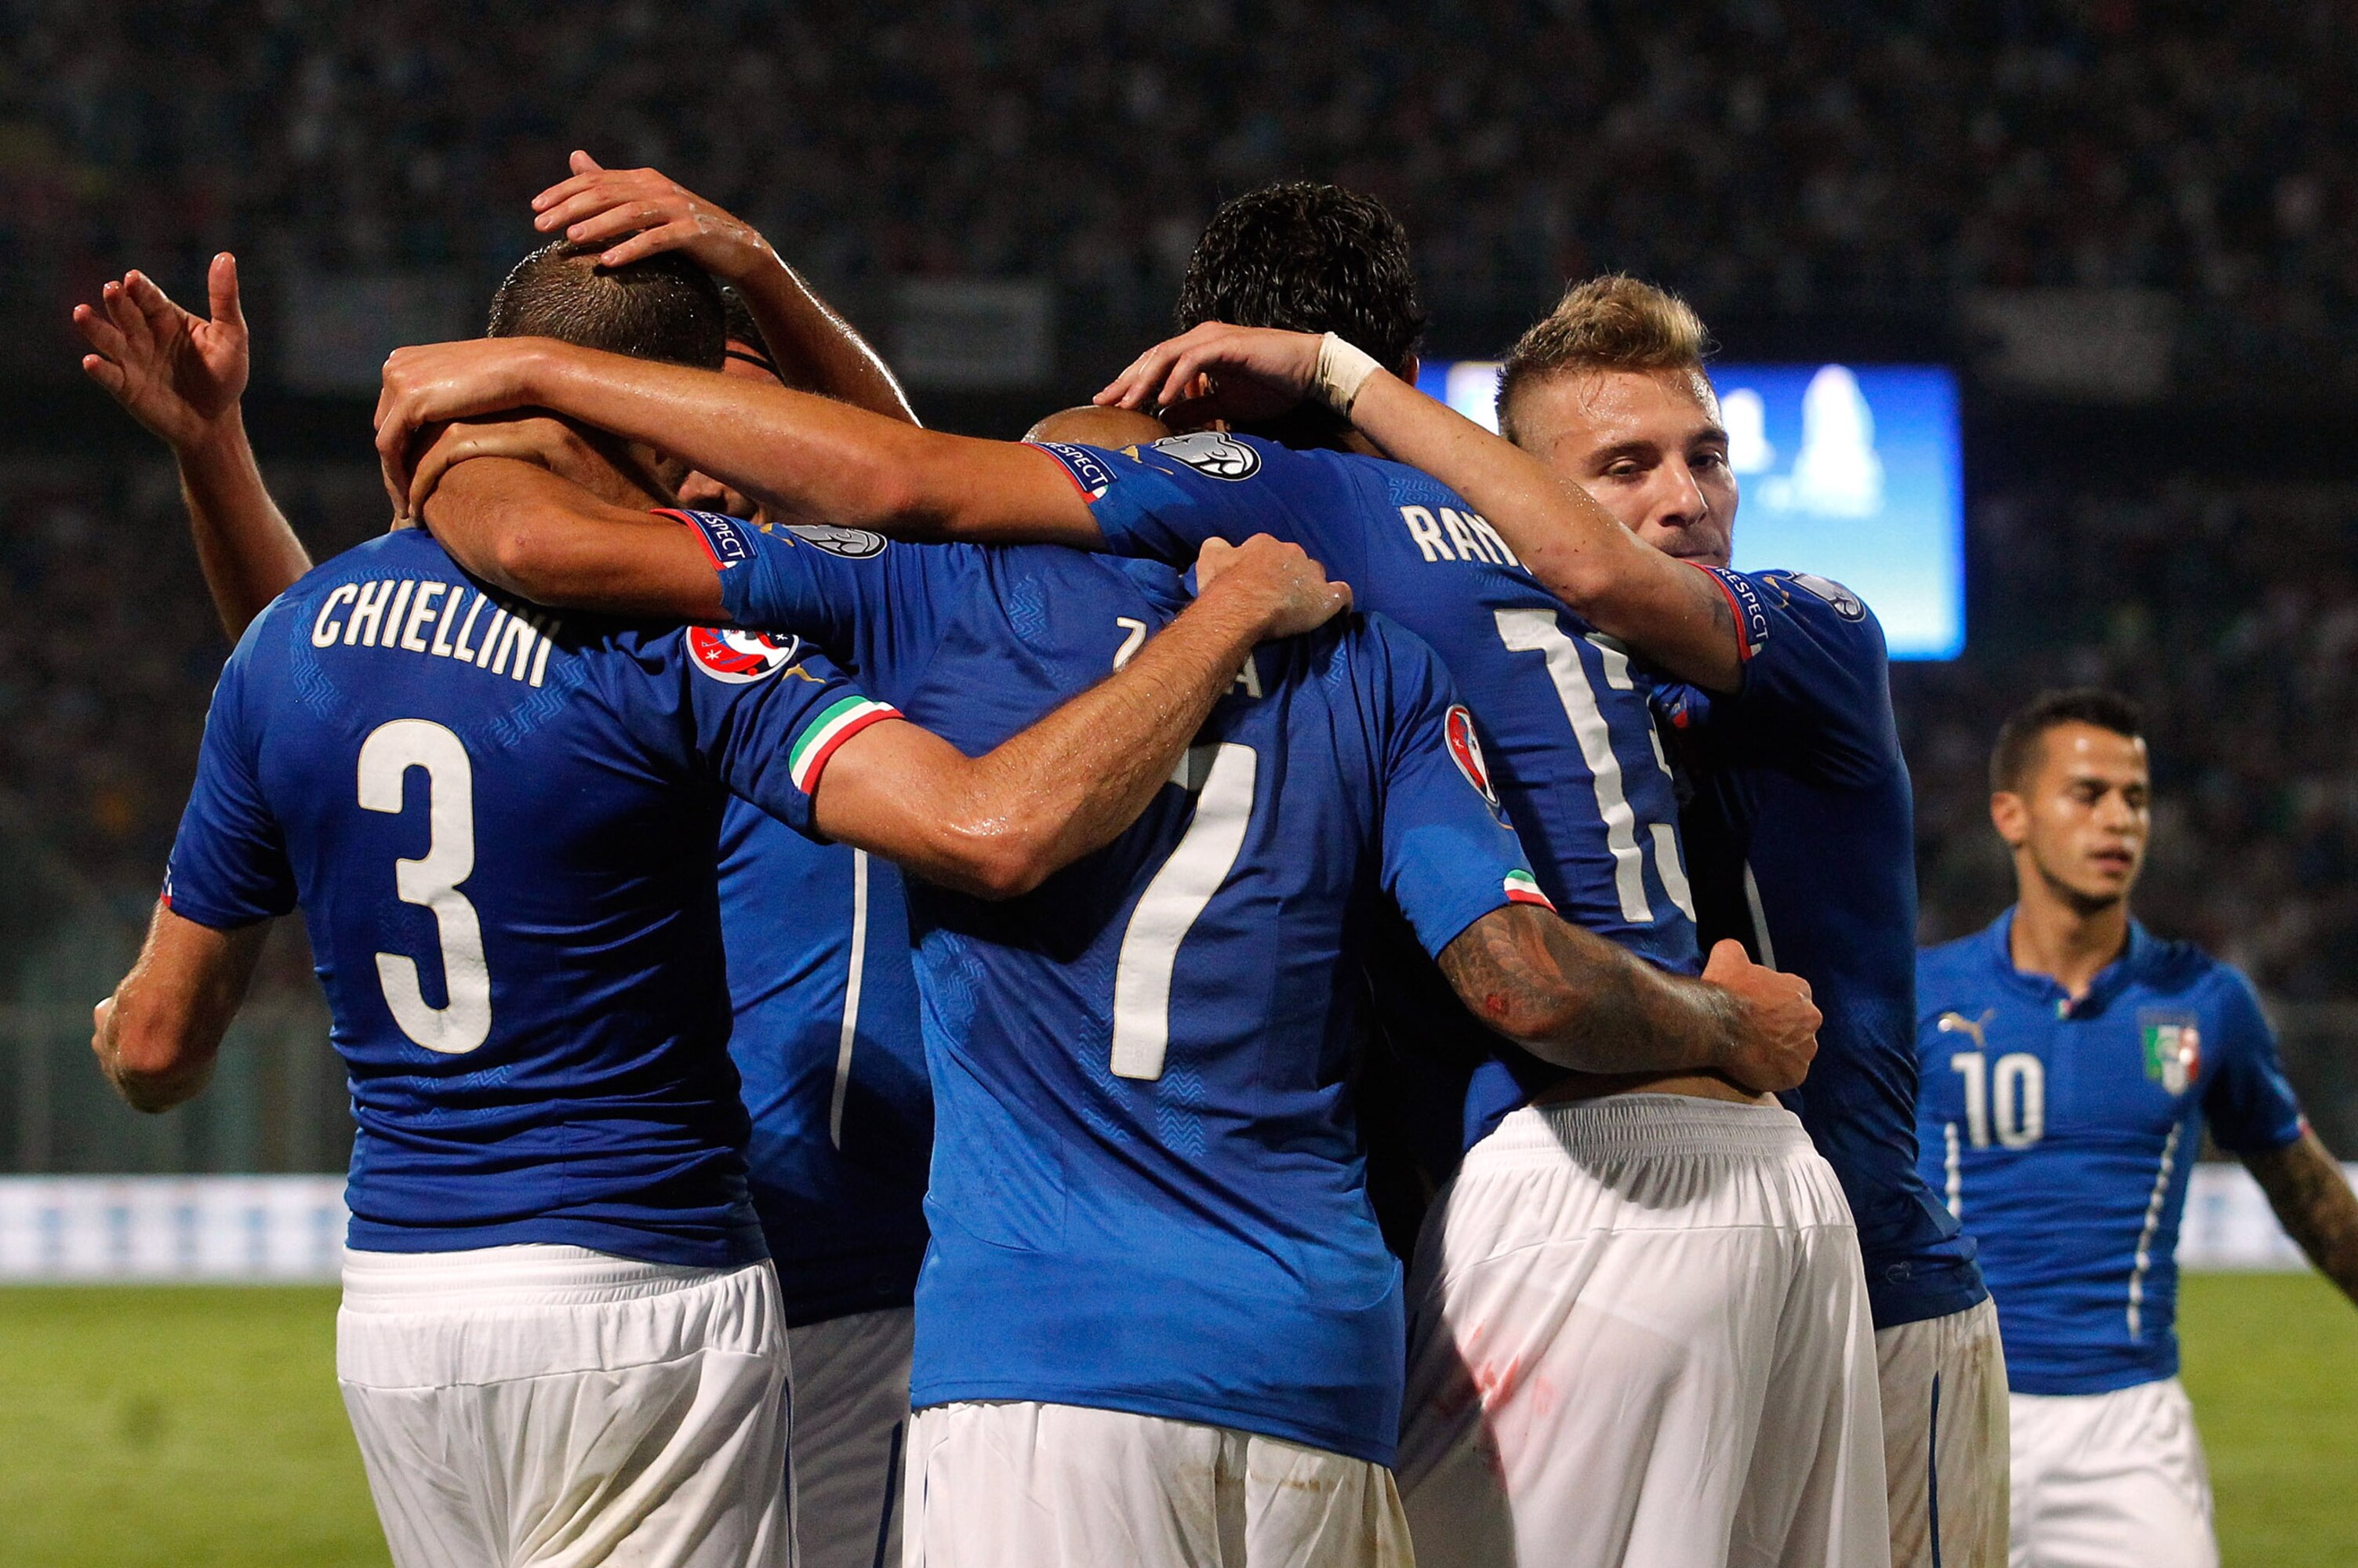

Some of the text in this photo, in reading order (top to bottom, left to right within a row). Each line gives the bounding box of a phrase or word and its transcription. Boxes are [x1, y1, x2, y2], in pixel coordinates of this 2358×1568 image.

[1400, 505, 1532, 575] RAN
[311, 579, 562, 688] CHIELLINI
[1113, 616, 1262, 699] ZA
[357, 718, 493, 1054] 3
[1110, 742, 1257, 1080] 7
[1950, 1051, 2045, 1151] 10
